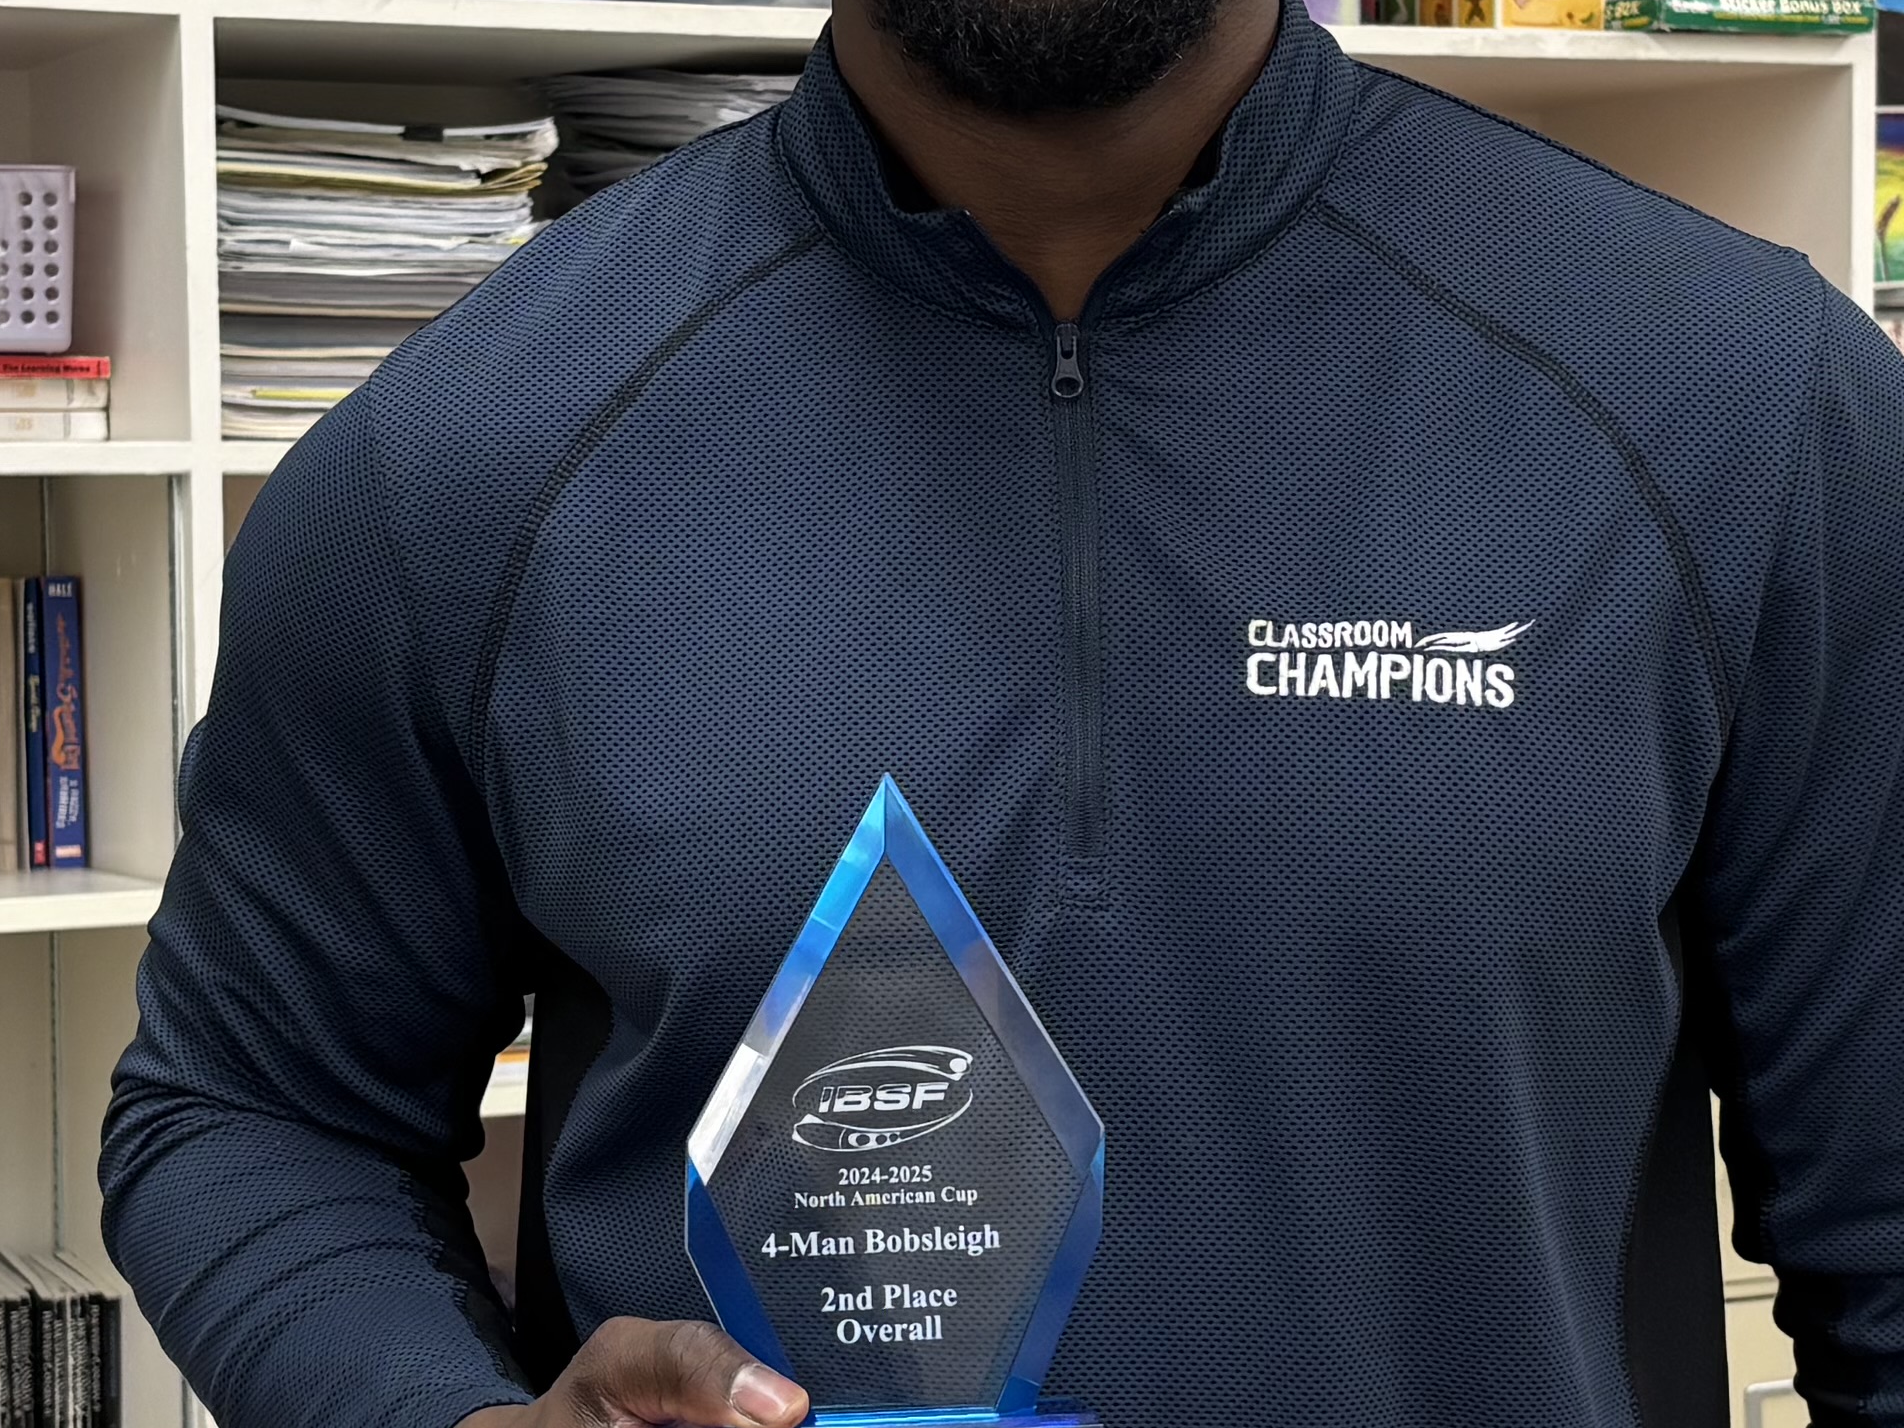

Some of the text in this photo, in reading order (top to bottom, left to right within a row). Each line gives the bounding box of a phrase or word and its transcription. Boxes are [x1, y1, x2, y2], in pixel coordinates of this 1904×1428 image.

[1247, 618, 1413, 649] CLASSROOM
[1245, 650, 1516, 709] CHAMPIONS
[818, 1081, 950, 1113] IBSF
[838, 1165, 933, 1186] 2024-2025
[794, 1186, 978, 1209] North American Cup
[761, 1224, 1001, 1258] 4-Man Bobsleigh
[820, 1283, 959, 1313] 2nd Place
[836, 1315, 944, 1345] Overall
